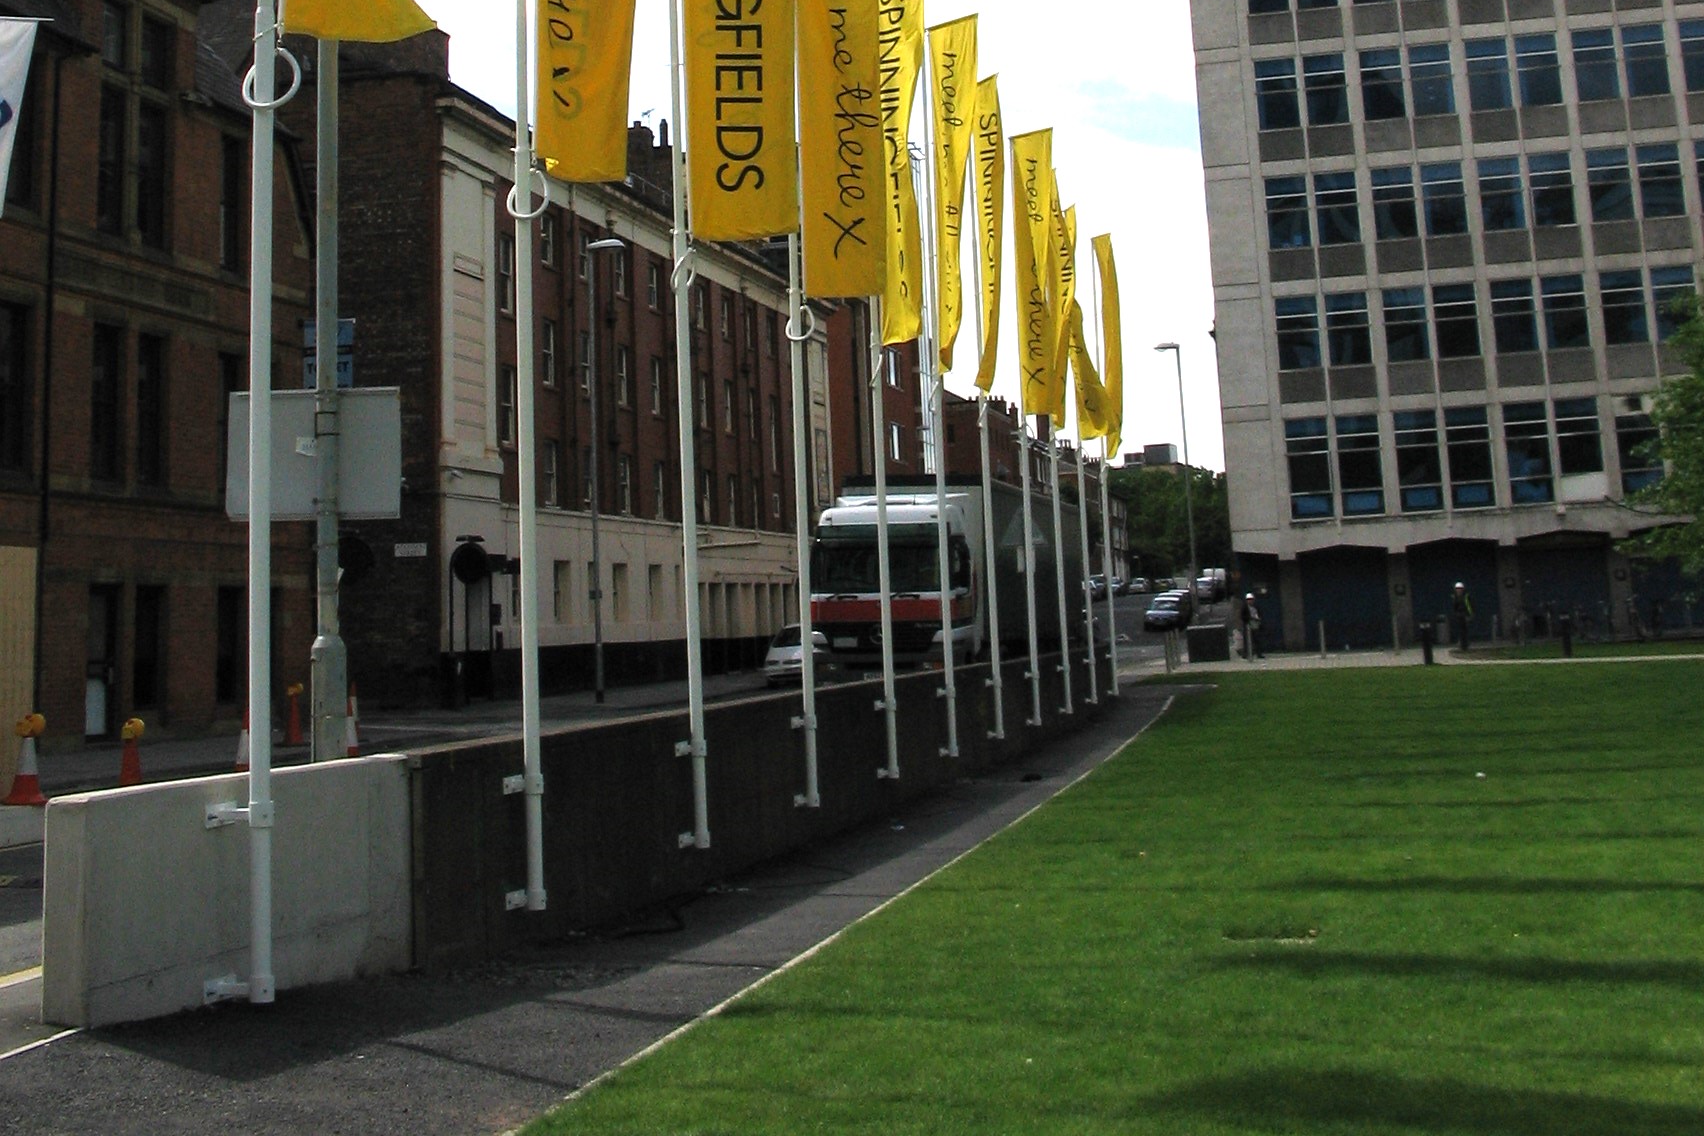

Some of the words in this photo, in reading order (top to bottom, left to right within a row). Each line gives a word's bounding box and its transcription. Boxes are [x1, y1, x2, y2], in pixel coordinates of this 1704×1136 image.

[829, 8, 853, 75] me
[941, 51, 963, 127] meet
[834, 81, 880, 208] there
[1025, 159, 1044, 223] meet
